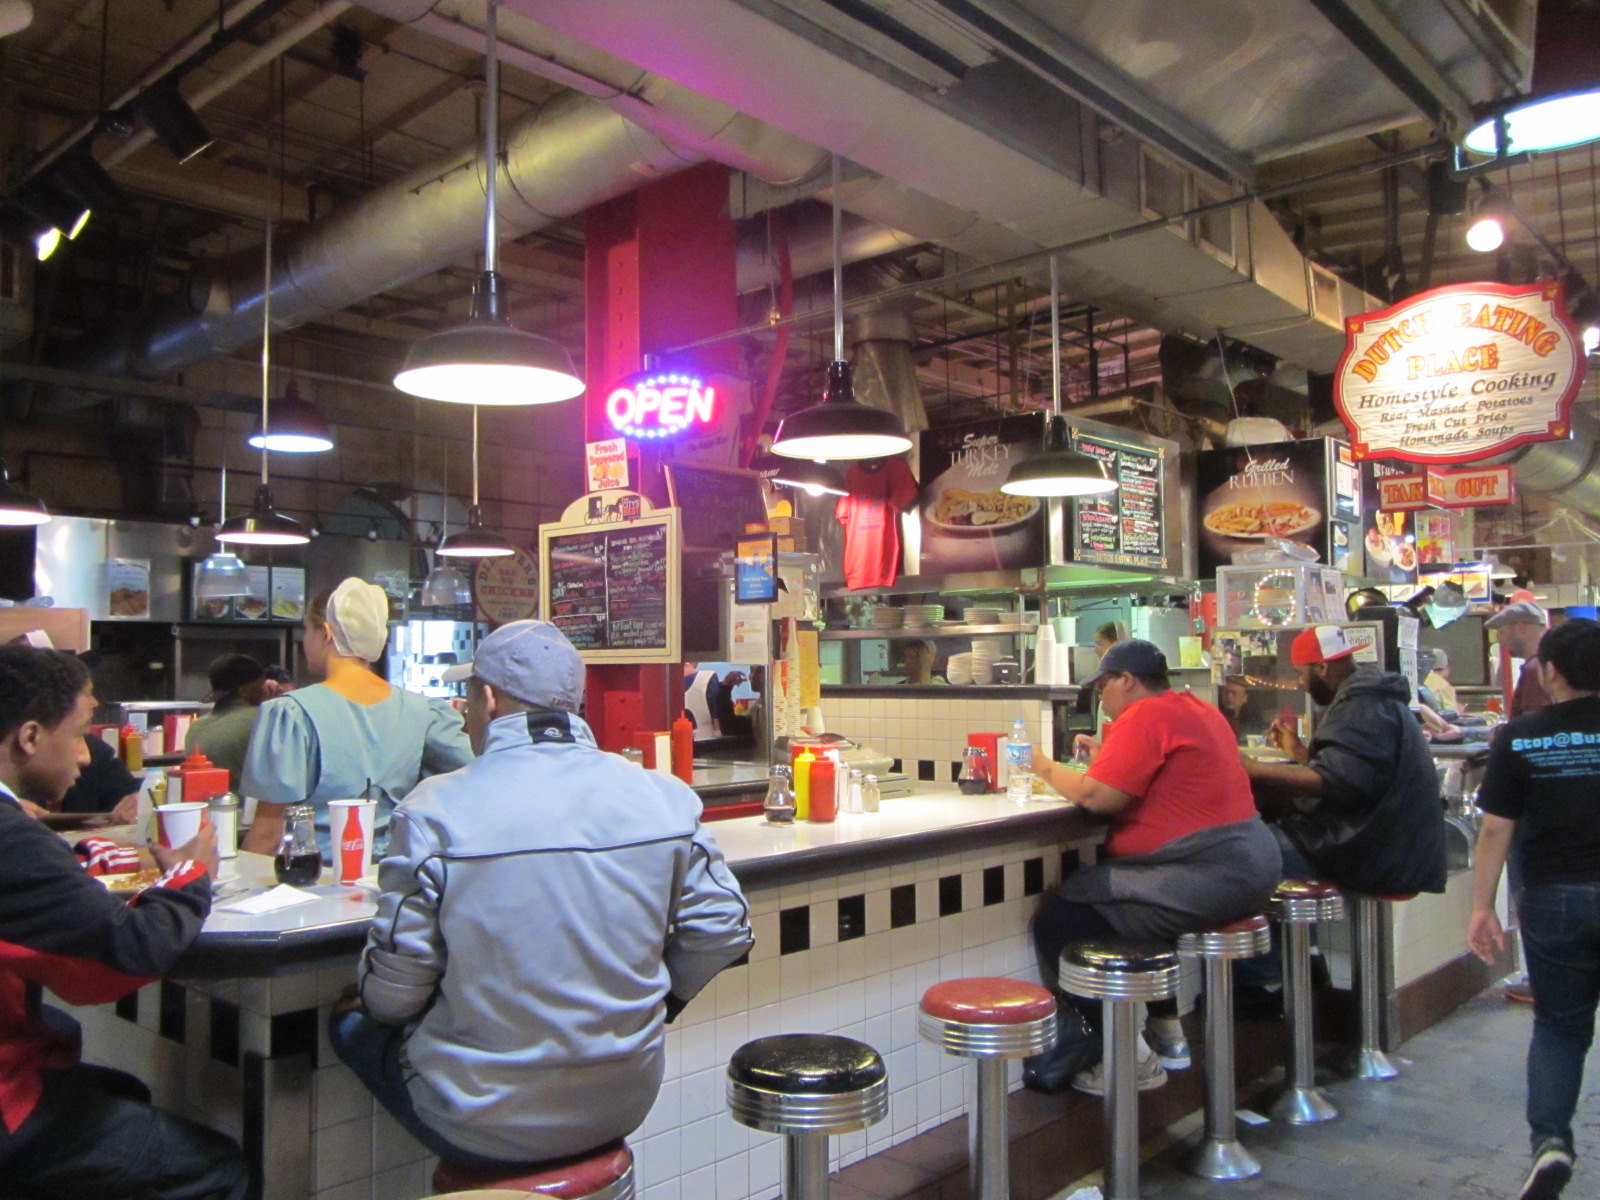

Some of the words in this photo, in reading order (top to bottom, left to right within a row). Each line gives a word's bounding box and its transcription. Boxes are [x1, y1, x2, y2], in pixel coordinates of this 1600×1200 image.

[1352, 310, 1433, 384] DUTCH
[1453, 302, 1561, 358] EATING
[1407, 343, 1500, 381] PLACE
[1358, 384, 1460, 411] Homestyle
[1471, 370, 1558, 394] Cooking
[607, 387, 715, 426] OPEN
[1380, 409, 1410, 424] Real
[1417, 403, 1467, 419] Mashed
[1476, 395, 1534, 412] Potatoes
[1404, 420, 1438, 435] Fresh
[1443, 415, 1468, 429] Cut
[1475, 411, 1509, 425] Fries
[962, 434, 999, 450] Super
[1399, 429, 1470, 448] Homemade
[1476, 424, 1515, 440] Soups
[594, 443, 618, 454] Fresh
[950, 443, 1010, 467] TURKEY
[1244, 457, 1290, 478] Grilled
[1384, 482, 1425, 505] TAK
[1454, 475, 1499, 498] OUT
[480, 585, 536, 598] CHICKEN
